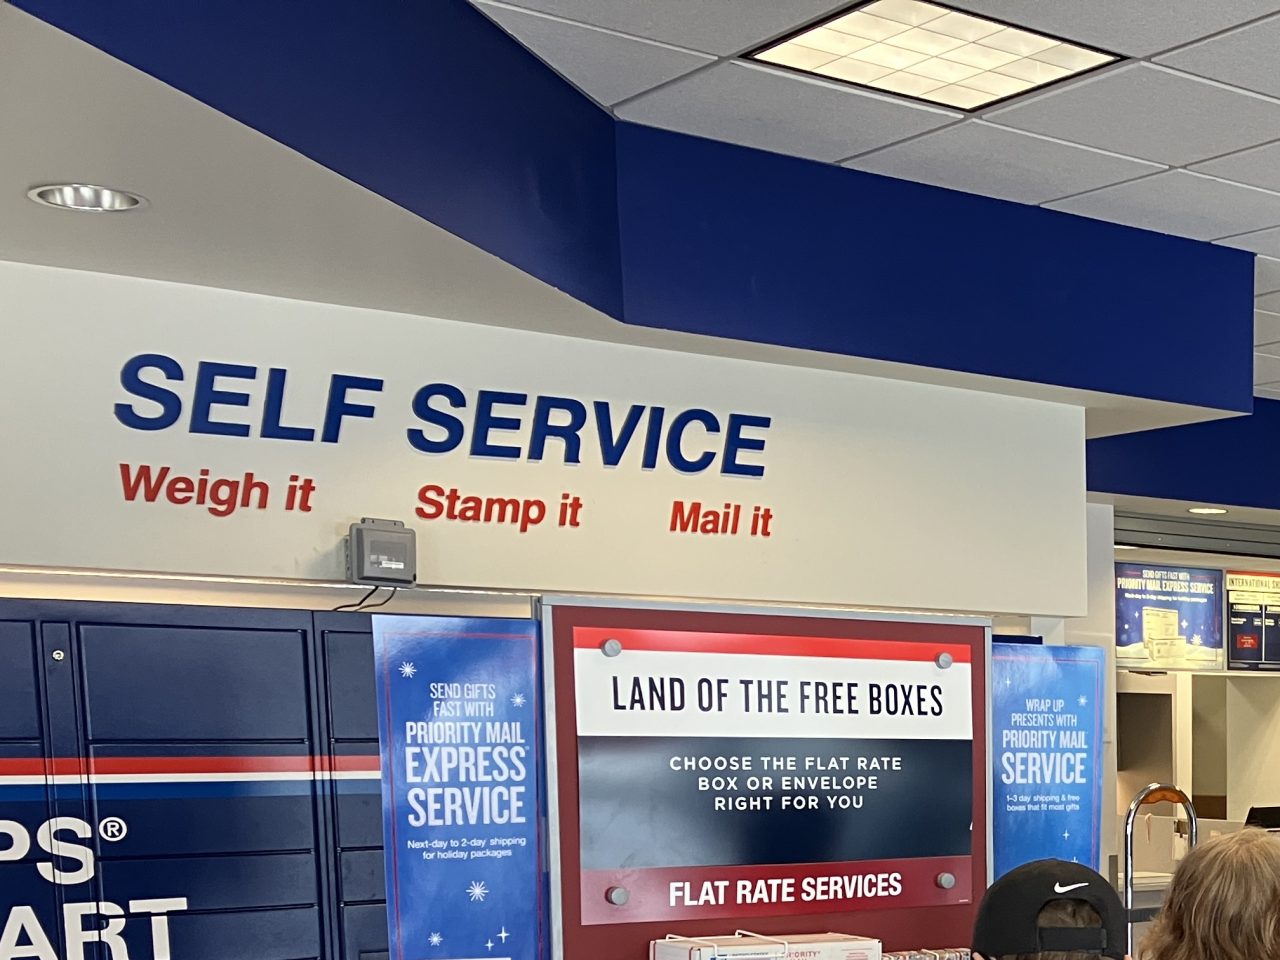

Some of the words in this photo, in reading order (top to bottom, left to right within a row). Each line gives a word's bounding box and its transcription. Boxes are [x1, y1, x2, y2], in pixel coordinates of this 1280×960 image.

[113, 353, 384, 444] SELF
[406, 382, 772, 478] SERVICE
[119, 463, 269, 517] Weigh
[285, 474, 315, 512] it
[415, 484, 546, 533] Stamp
[558, 493, 583, 527] it
[669, 500, 741, 535] Mail
[750, 505, 773, 537] it
[1117, 577, 1146, 590] PRIORITY
[1146, 578, 1161, 591] MAIL
[1162, 580, 1189, 593] EXPRESS
[1190, 582, 1214, 594] SERVICE
[1228, 577, 1271, 589] INTERNATIONAL
[429, 682, 461, 699] SEND
[464, 683, 496, 699] GIFTS
[612, 675, 685, 711] LAND
[697, 677, 729, 712] OF
[739, 679, 789, 713] THE
[800, 681, 858, 715] FREE
[869, 683, 943, 717] BOXES
[433, 701, 463, 717] FAST
[464, 701, 494, 717] WITH
[1026, 698, 1051, 712] WRAP
[1053, 699, 1064, 712] UP
[1011, 713, 1054, 727] PRESENTS
[1056, 714, 1078, 727] WITH
[405, 721, 482, 744] PRIORITY
[486, 721, 525, 744] MAIL
[1002, 730, 1057, 749] PRIORITY
[1059, 730, 1088, 749] MAIL
[405, 745, 526, 783] EXPRESS
[669, 756, 752, 771] CHOOSE
[760, 756, 797, 770] THE
[804, 756, 850, 770] FLAT
[857, 756, 902, 770] RATE
[1001, 752, 1088, 784] SERVICE
[698, 777, 738, 791] BOX
[746, 776, 773, 790] OR
[781, 776, 878, 790] ENVELOPE
[407, 786, 526, 827] SERVICE
[714, 796, 773, 811] RIGHT
[781, 796, 819, 810] FOR
[826, 795, 864, 809] YOU
[1018, 795, 1032, 803] day
[1033, 794, 1060, 803] shipping
[1006, 804, 1026, 812] boxes
[1028, 804, 1040, 812] that
[1066, 804, 1080, 812] gifts
[407, 839, 448, 850] Next-day
[450, 838, 460, 848] to
[461, 838, 486, 848] 2-day
[489, 836, 526, 847] shipping
[422, 851, 435, 860] for
[437, 850, 468, 860] holiday
[470, 849, 512, 859] packages
[669, 880, 730, 907] FLAT
[736, 878, 796, 905] RATE
[801, 872, 902, 901] SERVICES
